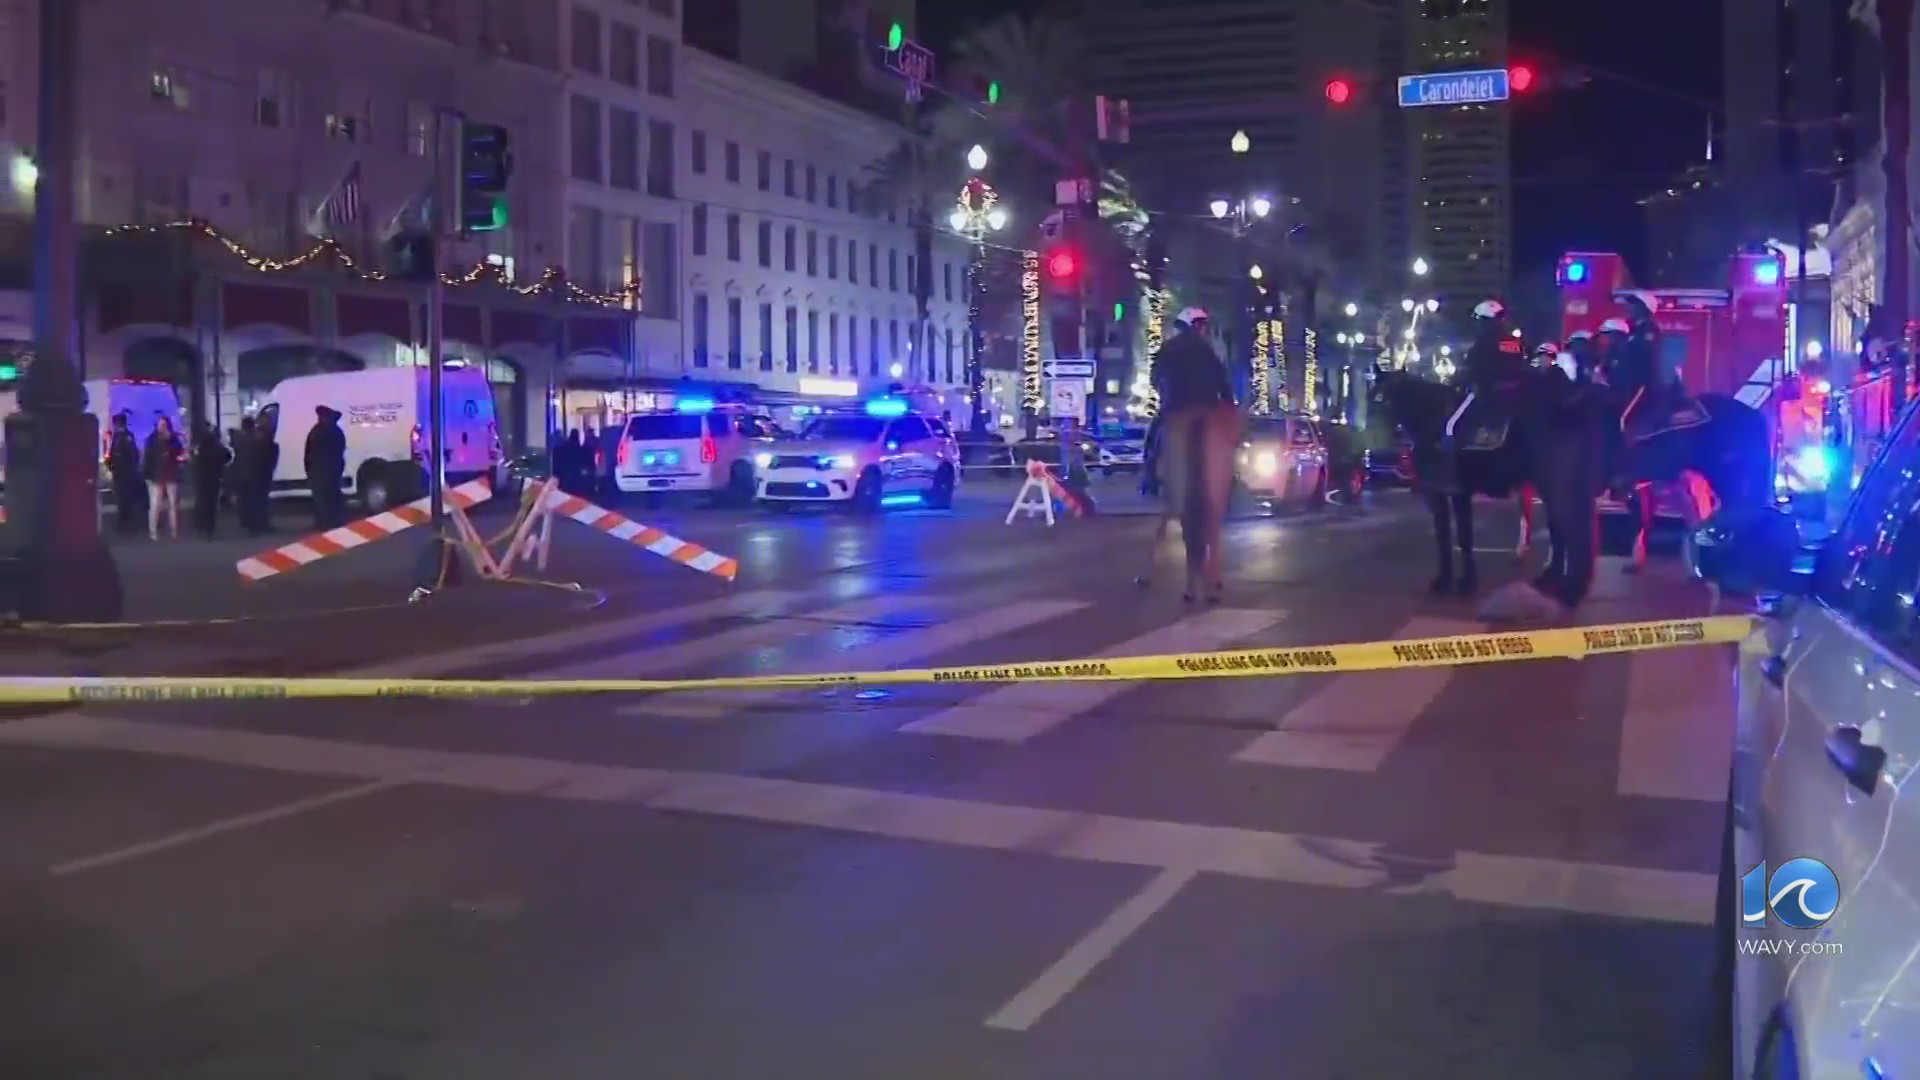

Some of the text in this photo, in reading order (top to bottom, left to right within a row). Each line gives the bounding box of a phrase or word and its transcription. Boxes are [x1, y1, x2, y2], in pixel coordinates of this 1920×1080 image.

[1419, 75, 1494, 101] Carondelet
[1393, 644, 1433, 661] POLICE
[1433, 642, 1458, 658] LINE
[1473, 639, 1496, 656] NOT
[1177, 656, 1223, 671] POLICE
[1220, 655, 1250, 669] LINE
[1268, 653, 1294, 667] NOT
